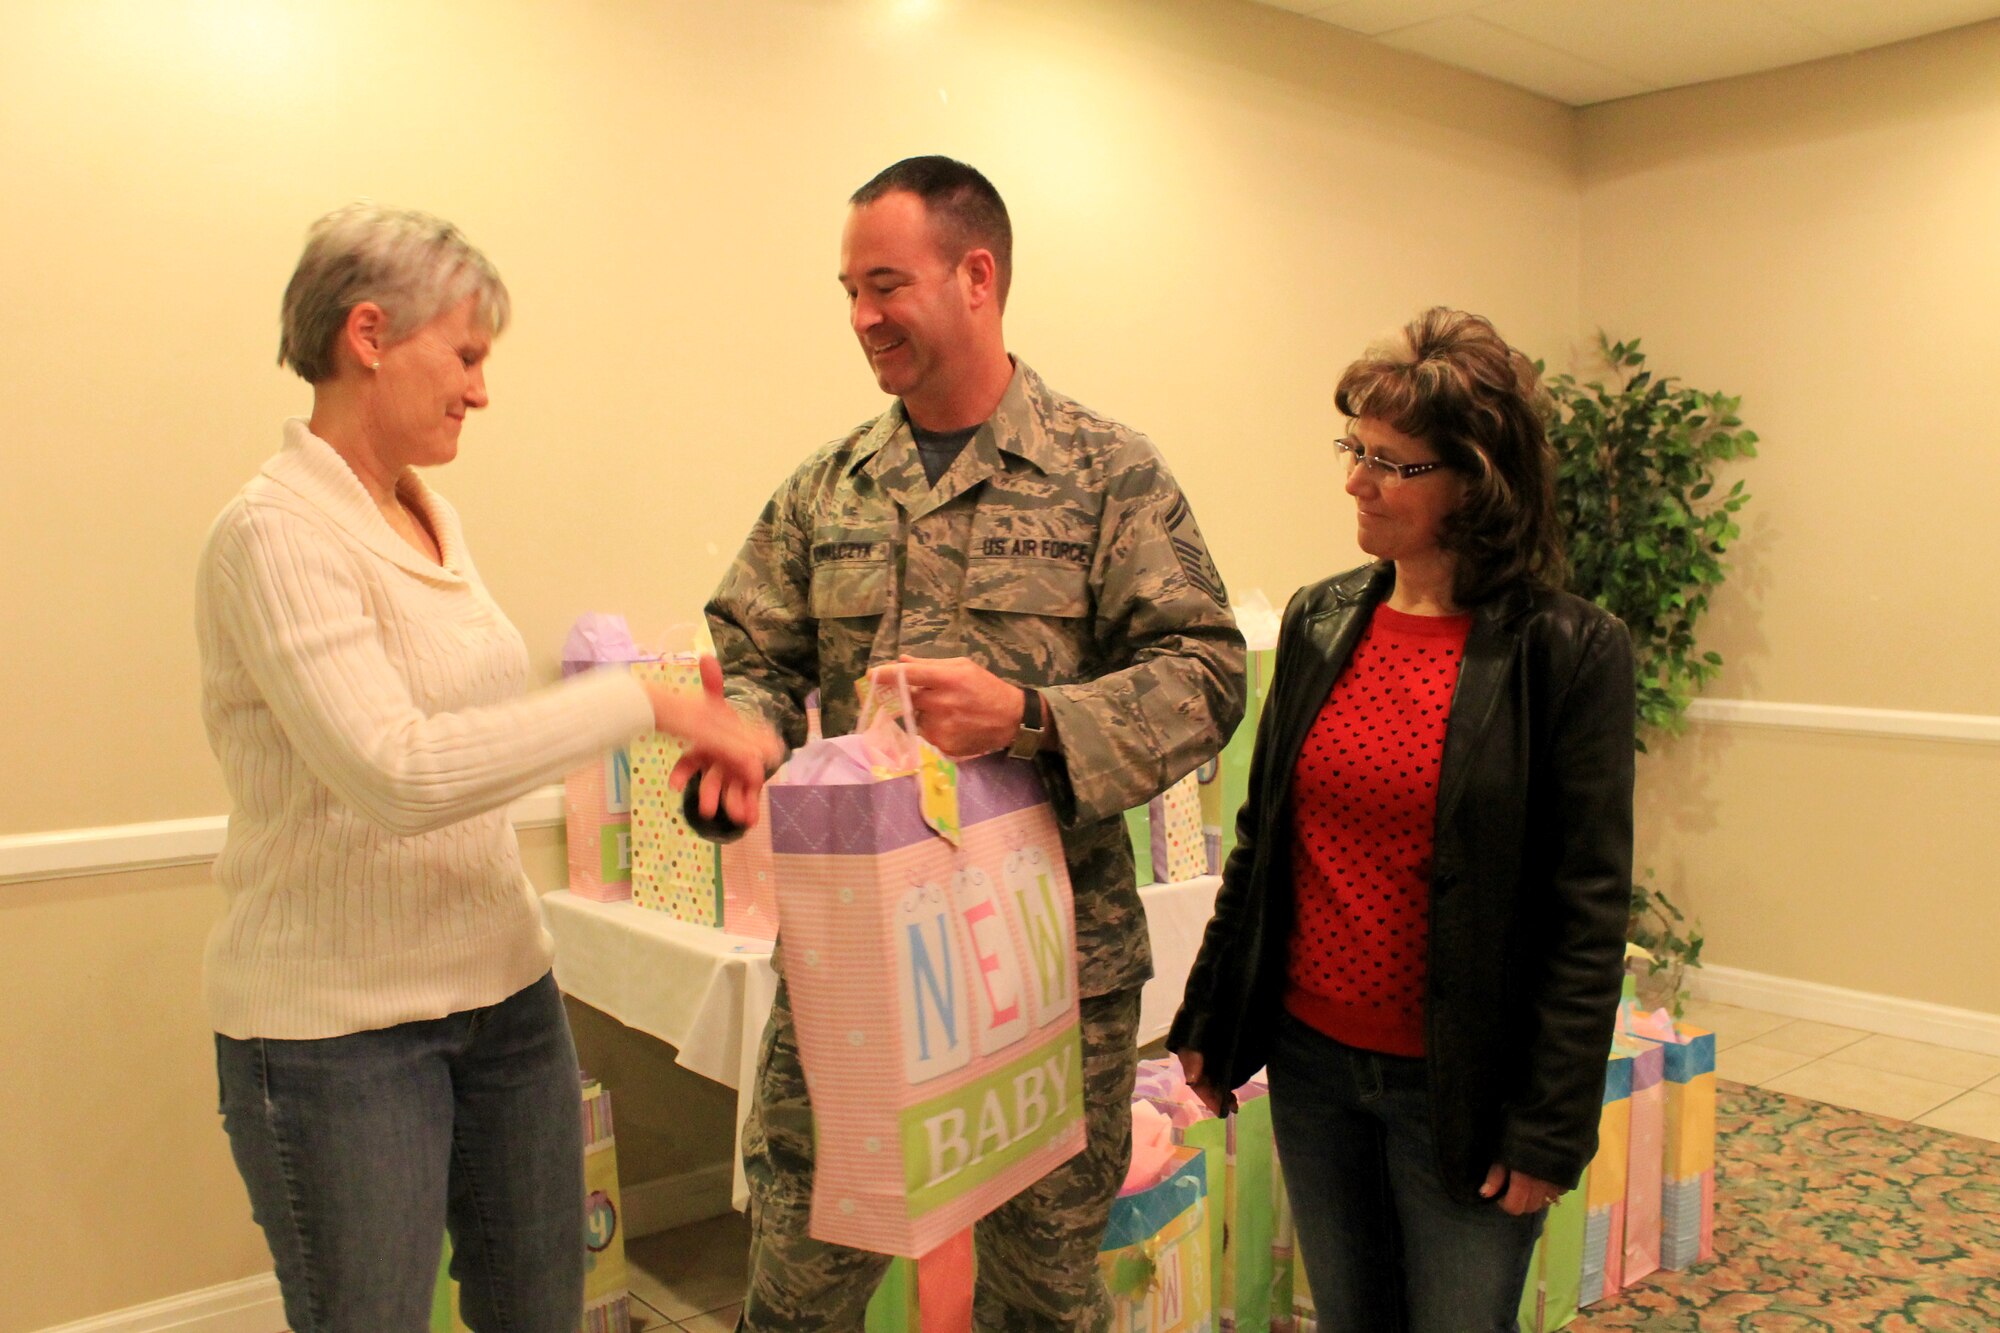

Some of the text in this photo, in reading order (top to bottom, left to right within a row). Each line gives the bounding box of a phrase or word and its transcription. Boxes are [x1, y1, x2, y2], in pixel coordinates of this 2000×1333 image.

[983, 538, 1089, 561] US AIR FORCE
[906, 873, 1066, 1061] NEW
[924, 1045, 1072, 1188] BABY
